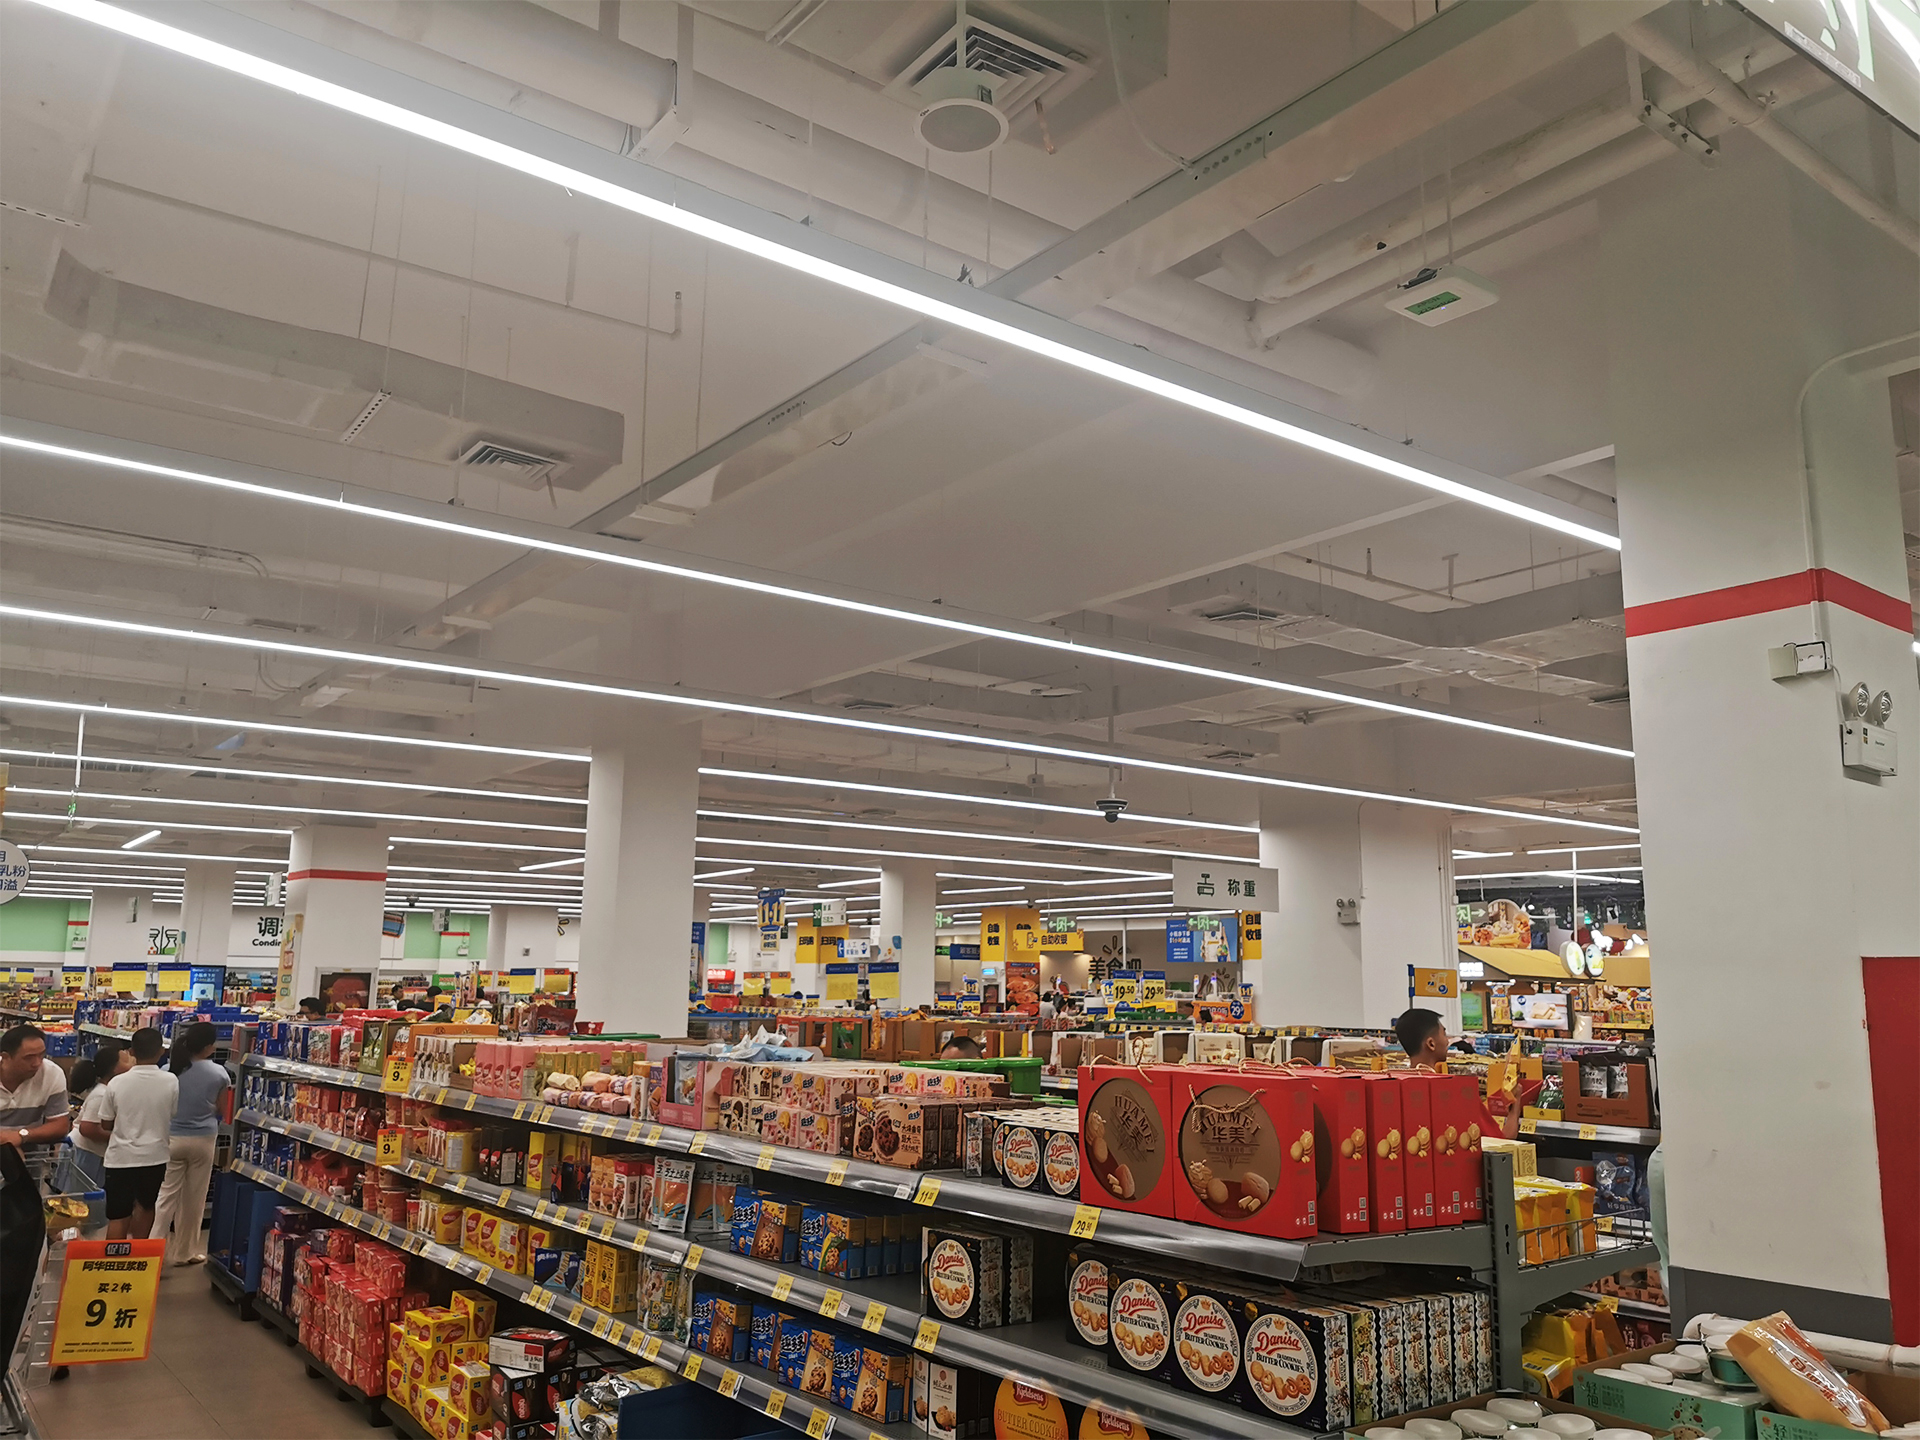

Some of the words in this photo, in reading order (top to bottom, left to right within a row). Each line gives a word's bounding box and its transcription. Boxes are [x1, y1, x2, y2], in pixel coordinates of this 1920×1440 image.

[1227, 879, 1256, 897] 称重
[64, 976, 83, 986] 5.50
[1115, 985, 1135, 999] 19.50
[1144, 986, 1164, 999] 29.90
[1114, 1095, 1156, 1153] HUAMEI
[1120, 1110, 1146, 1147] 华美
[1199, 1111, 1261, 1137] HUAMEI
[1211, 1125, 1246, 1144] 华美
[1073, 1220, 1093, 1235] 29.90
[106, 1243, 131, 1255] 促销
[82, 1260, 148, 1272] 阿华田豆浆粉
[934, 1251, 965, 1272] Danisa
[98, 1282, 133, 1293] 买2件
[1118, 1293, 1158, 1316] Danisa
[1120, 1314, 1139, 1327] BUTTER
[1138, 1319, 1160, 1331] COOKIES
[1183, 1311, 1226, 1335] Danisa
[1184, 1332, 1206, 1345] BUTTER
[1204, 1338, 1229, 1351] COOKIES
[1255, 1331, 1301, 1356] Danisa
[1256, 1352, 1280, 1367] BUTTER
[1279, 1359, 1305, 1374] COOKIES
[997, 1408, 1028, 1431] BUTTER
[1029, 1418, 1066, 1440] COOKIES
